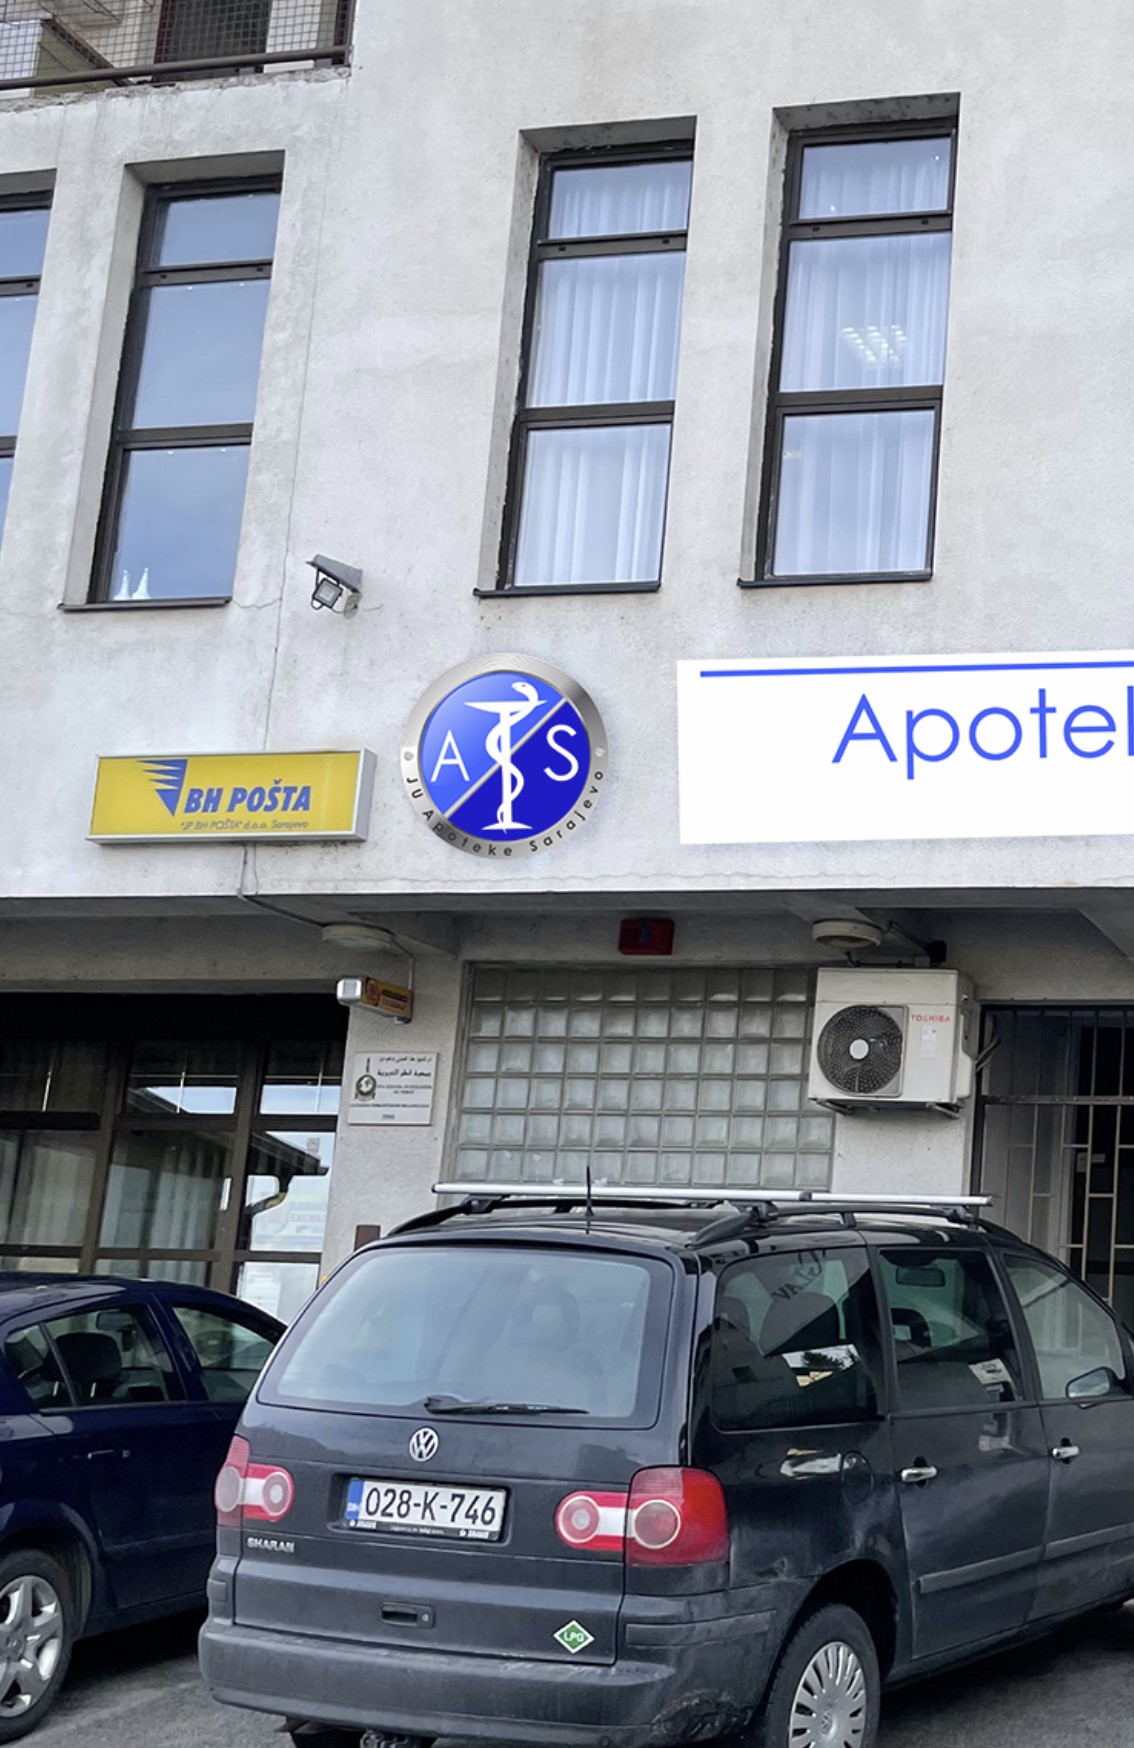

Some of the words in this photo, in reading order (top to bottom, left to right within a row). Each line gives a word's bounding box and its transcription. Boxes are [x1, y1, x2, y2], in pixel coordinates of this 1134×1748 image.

[430, 729, 470, 782] A
[544, 724, 579, 782] S
[184, 788, 223, 813] BH
[227, 778, 312, 813] POŠTA
[406, 776, 424, 799] JU
[422, 809, 513, 857] Apoteke
[529, 770, 605, 853] Sarajevo
[365, 1486, 496, 1526] 028-K-746
[247, 1536, 295, 1554] SHARAN
